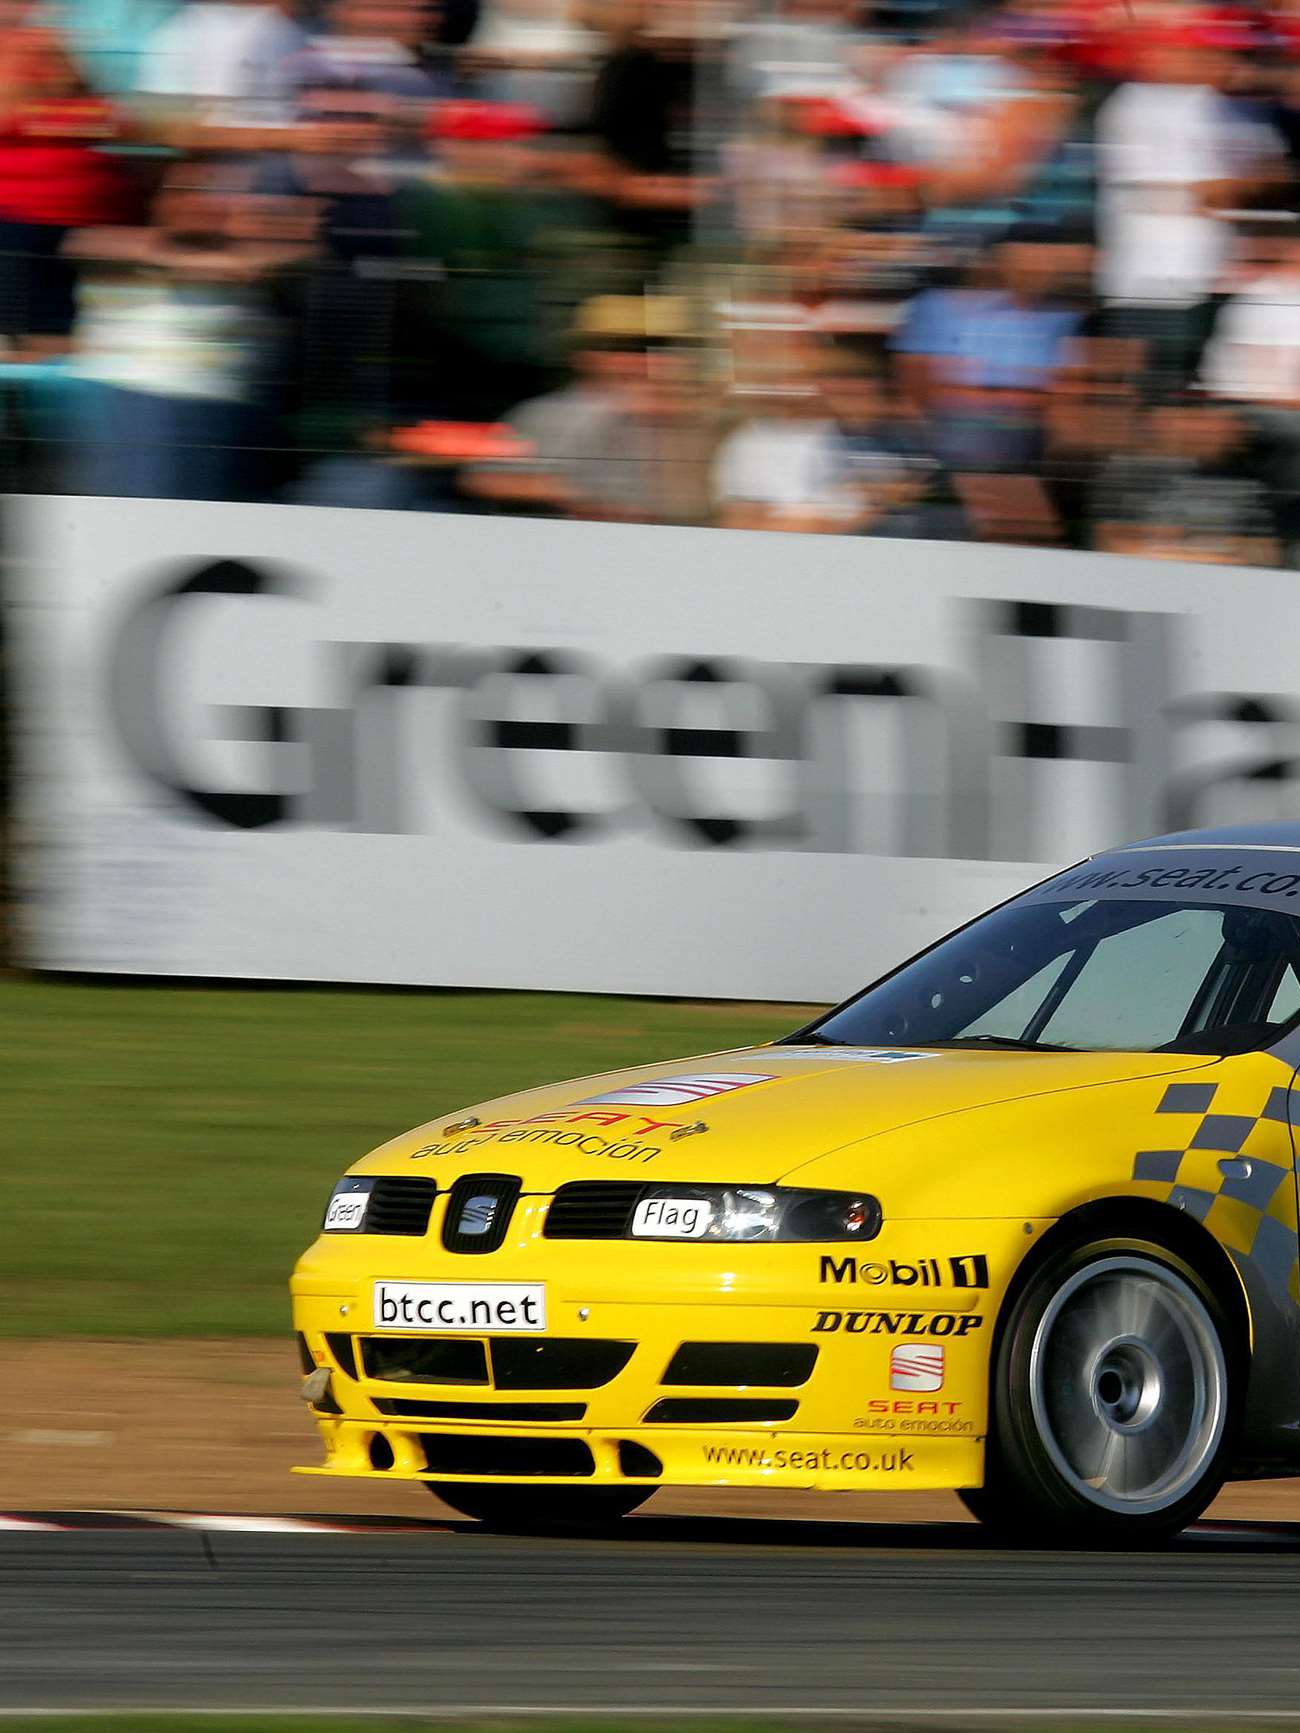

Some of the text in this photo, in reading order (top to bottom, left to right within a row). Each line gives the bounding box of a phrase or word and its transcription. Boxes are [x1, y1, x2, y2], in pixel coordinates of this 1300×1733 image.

[472, 1111, 684, 1136] SEAT
[498, 1128, 661, 1163] emoción
[644, 1201, 700, 1234] Flag
[820, 1255, 942, 1287] Mobil
[379, 1287, 540, 1325] btcc.net
[811, 1311, 983, 1337] DUNLOP
[867, 1400, 963, 1415] SEAT
[853, 1416, 895, 1430] auto
[702, 1447, 915, 1472] www.seat.co.uk
